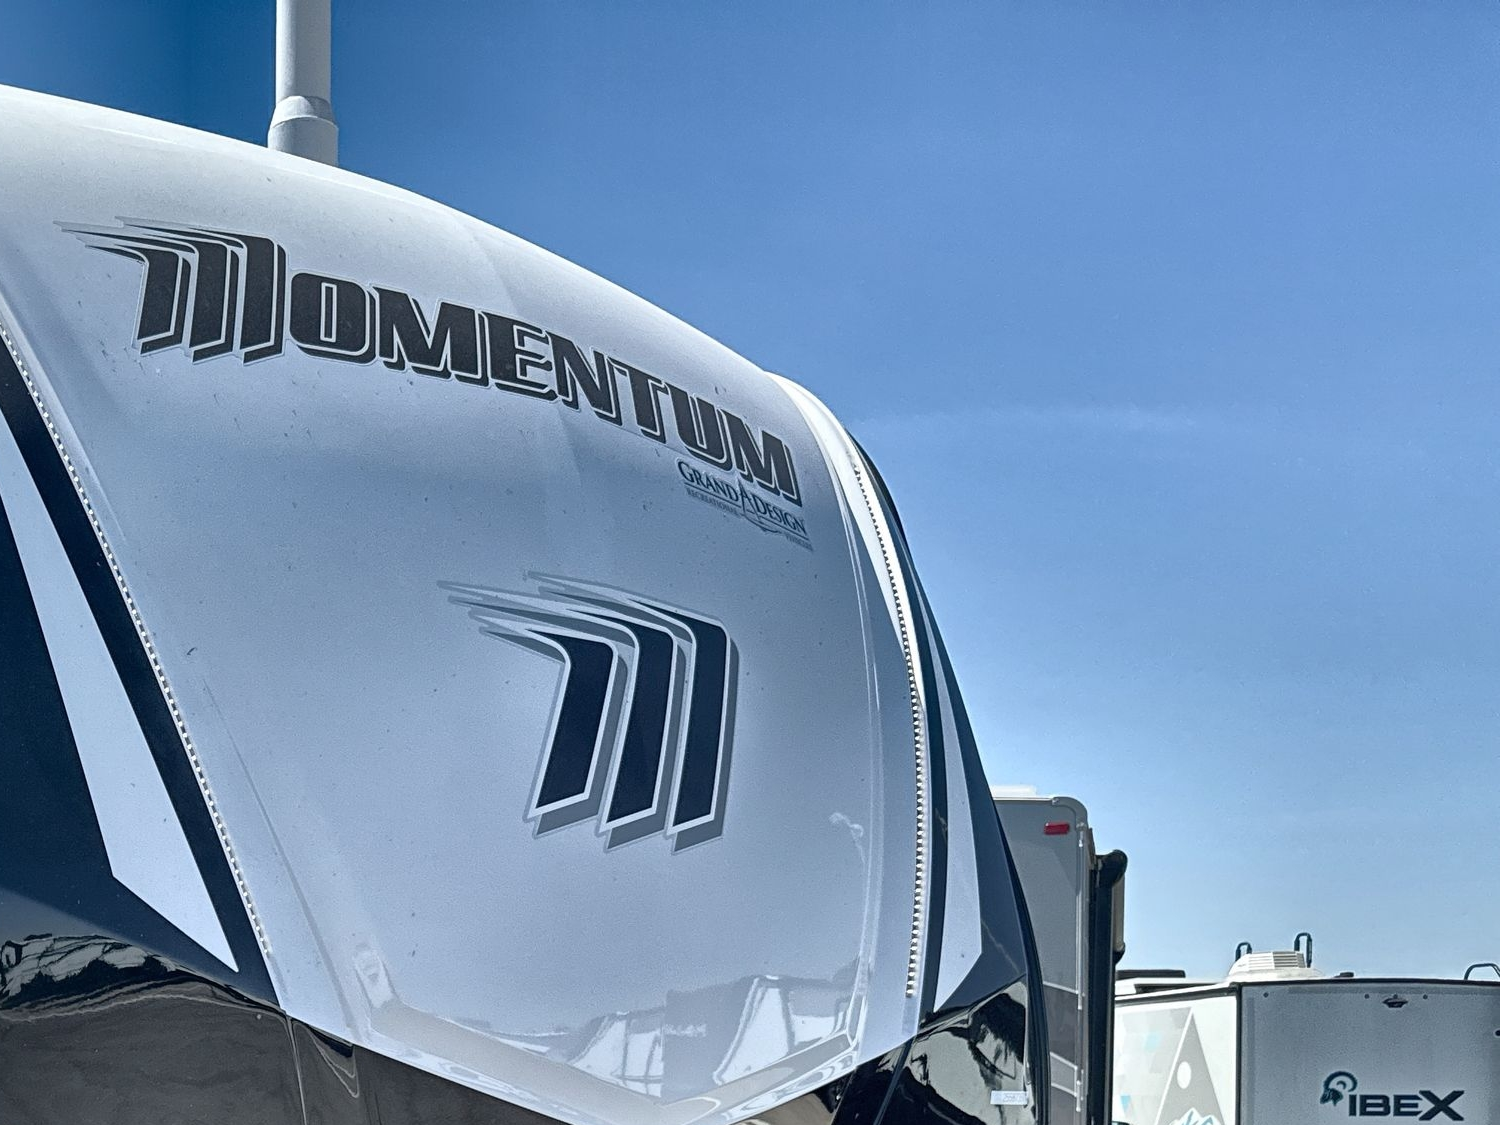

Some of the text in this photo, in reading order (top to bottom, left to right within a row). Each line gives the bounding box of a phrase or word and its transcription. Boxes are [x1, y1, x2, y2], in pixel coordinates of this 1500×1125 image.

[55, 217, 803, 508] MOMENTUM
[678, 461, 808, 536] GRAND DESIGN
[1349, 1090, 1464, 1121] IBEX
